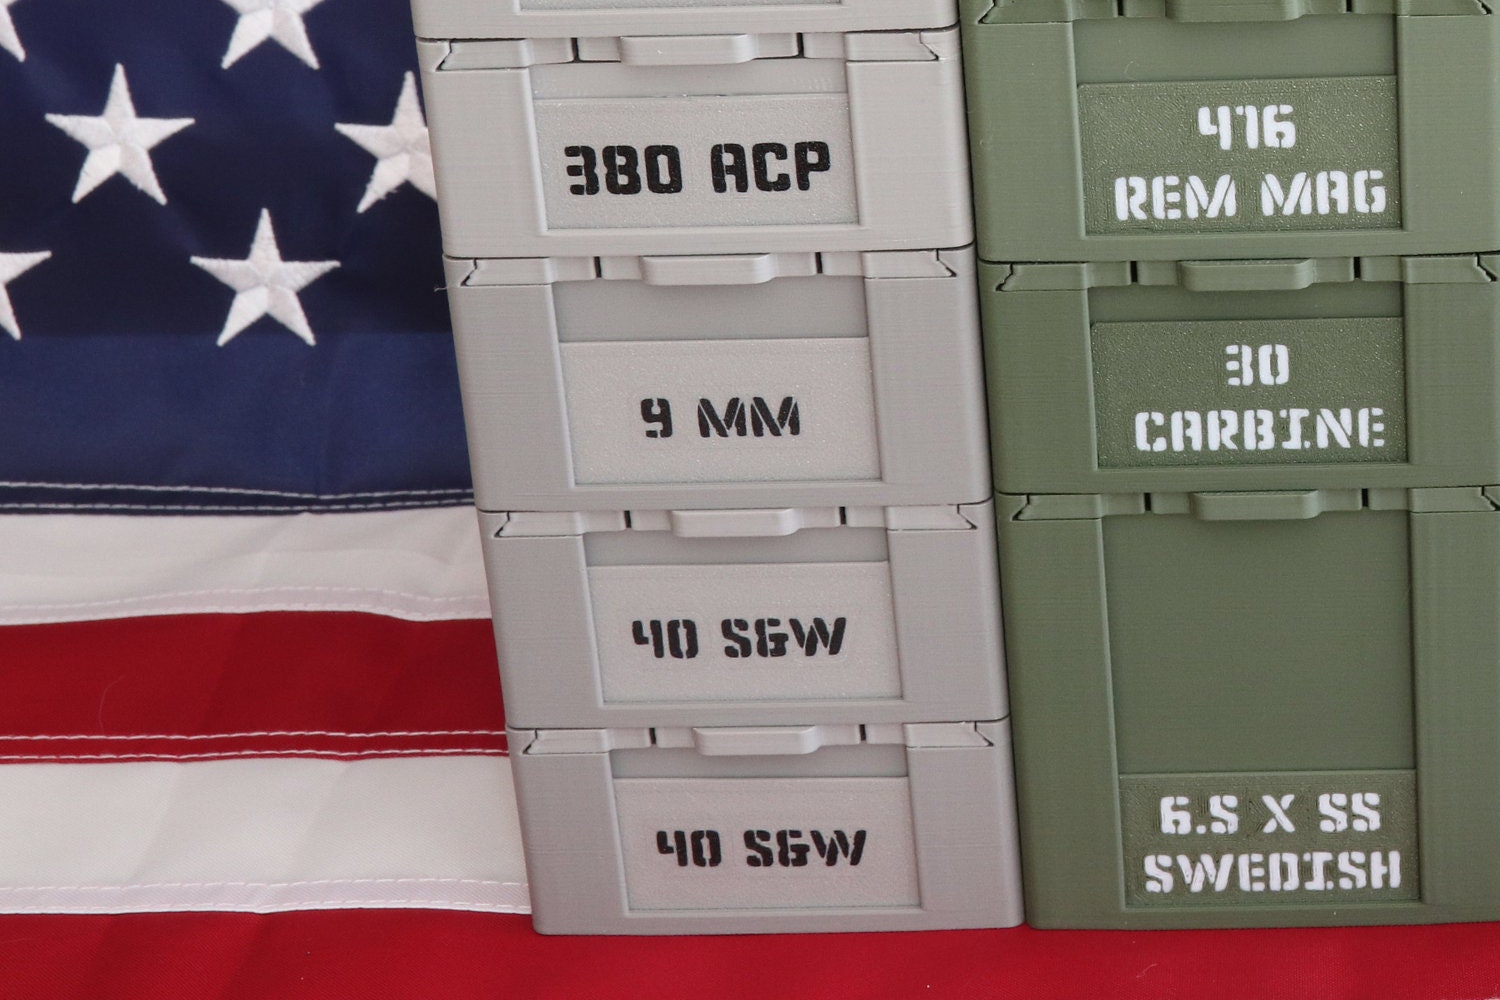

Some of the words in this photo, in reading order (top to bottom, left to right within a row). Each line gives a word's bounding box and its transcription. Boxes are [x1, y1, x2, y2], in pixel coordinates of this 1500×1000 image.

[1197, 104, 1296, 151] 416
[564, 144, 683, 196] 380
[710, 140, 831, 194] ACP
[1114, 174, 1237, 221] REM
[1260, 169, 1386, 217] MAG
[1225, 344, 1290, 386] 30
[640, 397, 673, 439] 9
[697, 396, 801, 438] MM
[1135, 407, 1385, 452] CARBINE
[631, 619, 699, 659] 40
[720, 616, 847, 659] S&W
[1160, 795, 1239, 835] 6.5
[1262, 794, 1295, 833] X
[1318, 792, 1381, 833] 55
[656, 829, 722, 868] 40
[743, 829, 867, 868] S&W
[1144, 851, 1401, 893] SWEDISH
